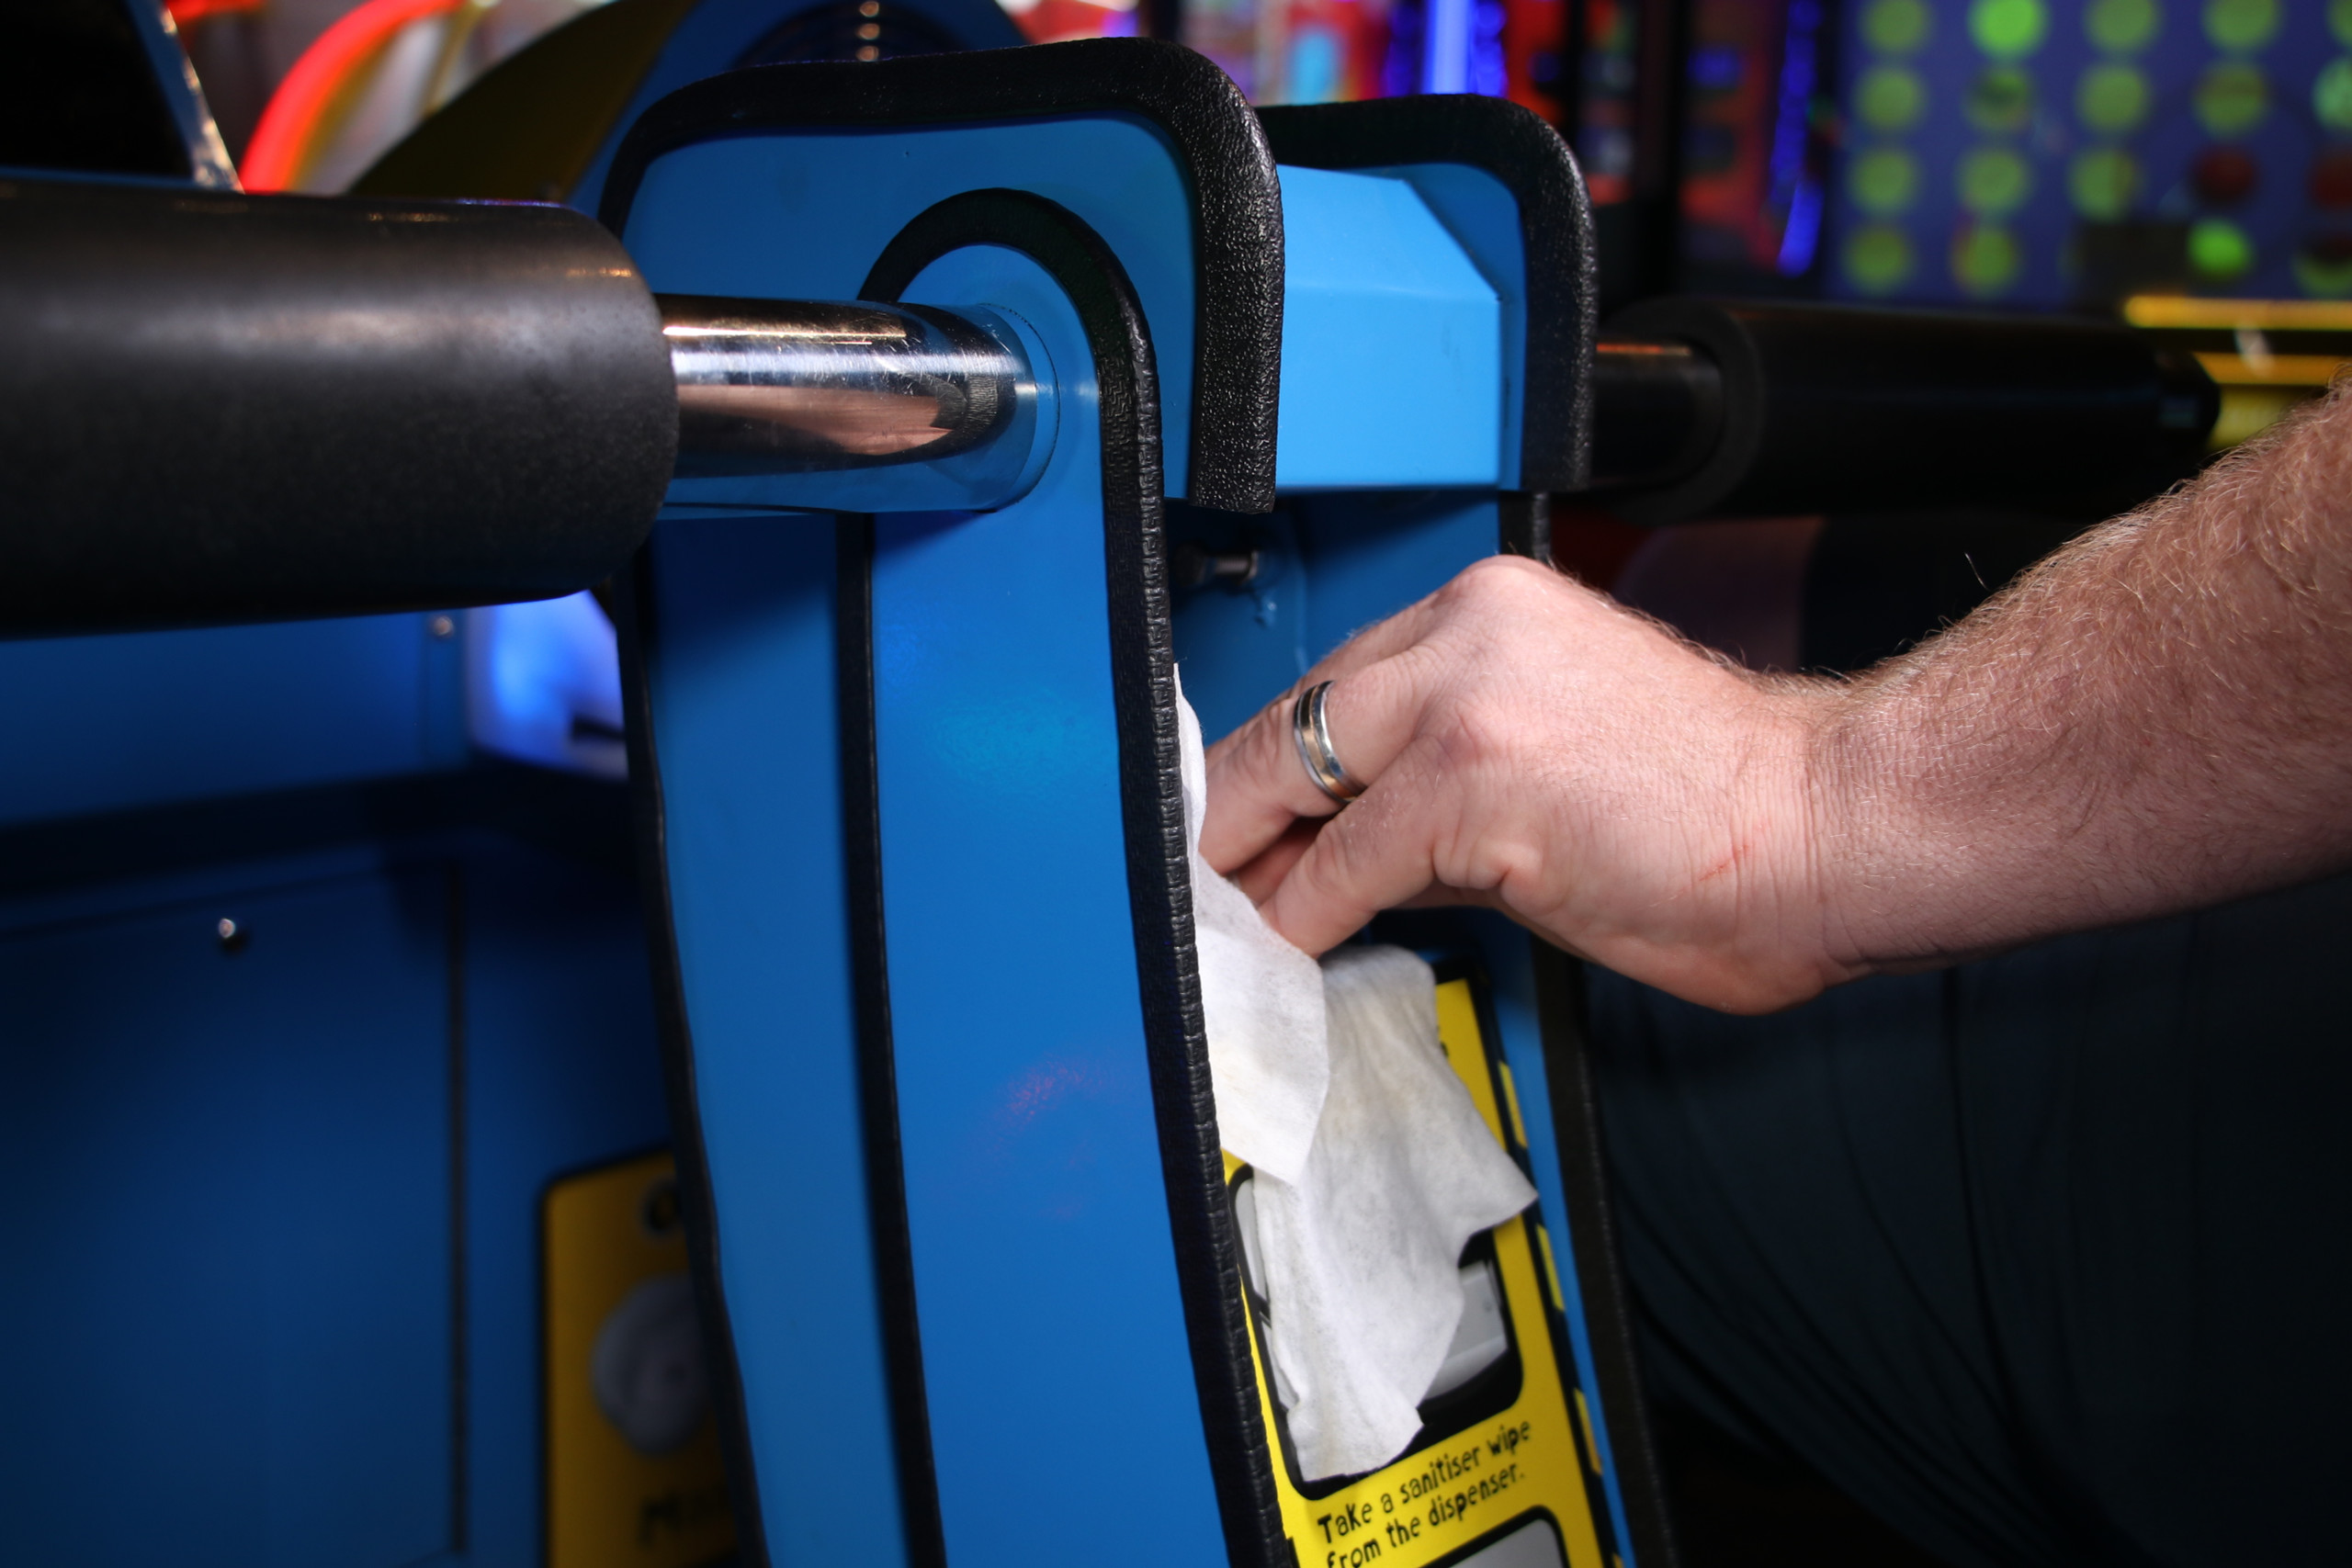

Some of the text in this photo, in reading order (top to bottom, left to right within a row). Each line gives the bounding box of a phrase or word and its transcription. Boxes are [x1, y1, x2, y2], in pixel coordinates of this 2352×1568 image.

[1327, 1461, 1526, 1568] from the dispenser.
[1380, 1493, 1395, 1514] a
[1400, 1448, 1481, 1505] sanitiser
[1487, 1421, 1531, 1457] wipe
